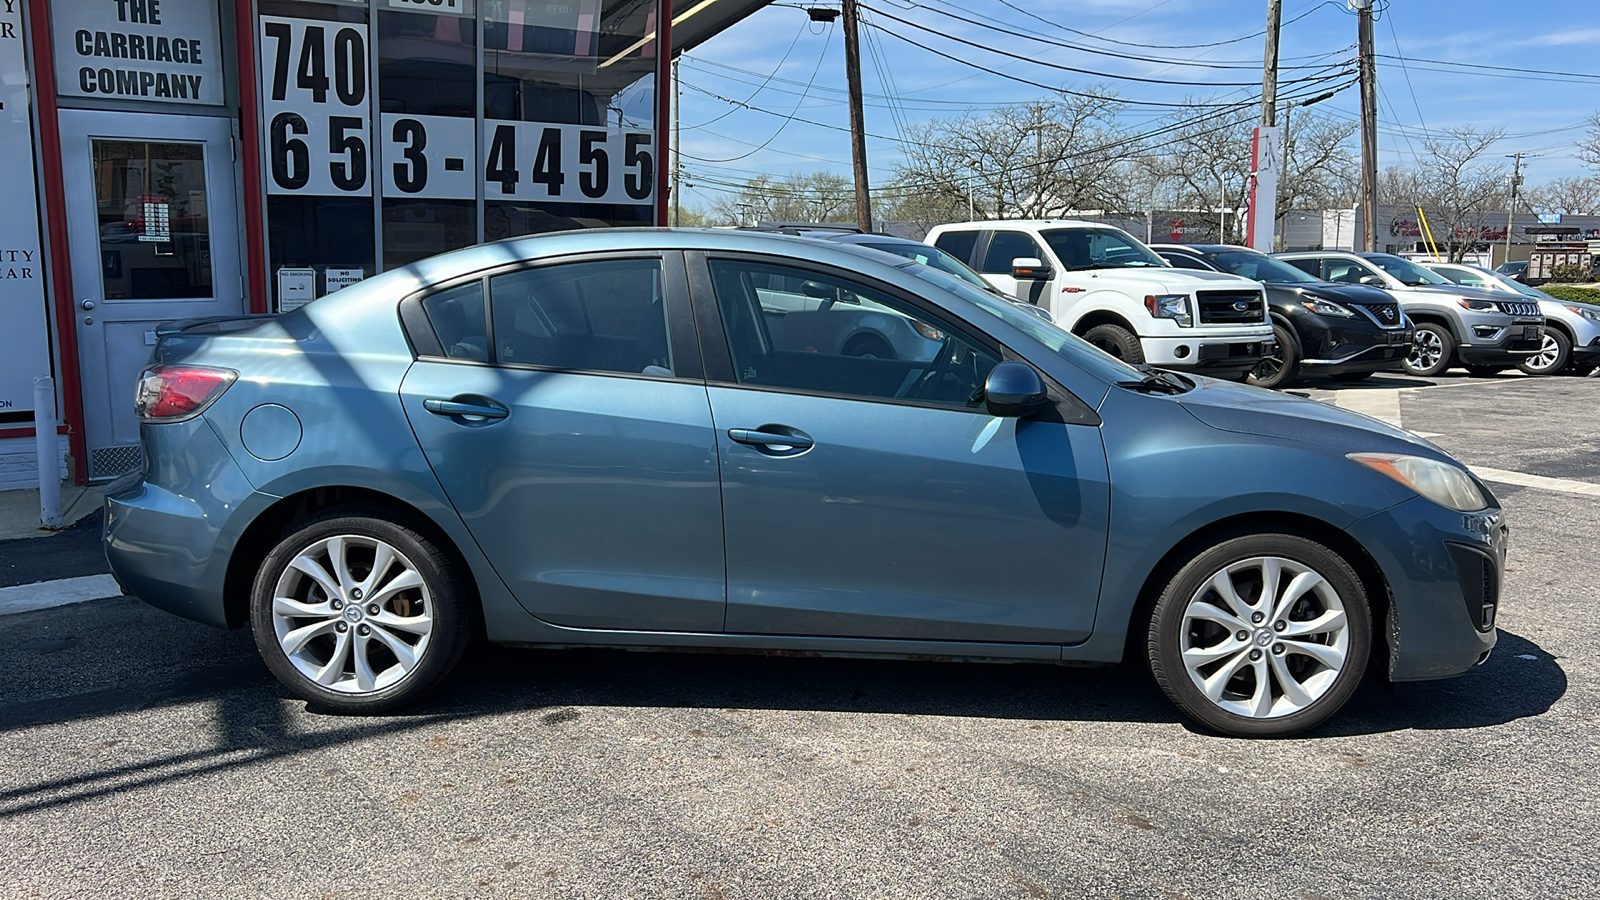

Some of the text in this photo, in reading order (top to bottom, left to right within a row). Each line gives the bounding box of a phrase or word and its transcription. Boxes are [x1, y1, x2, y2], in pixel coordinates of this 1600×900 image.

[116, 0, 162, 25] THE
[75, 29, 203, 65] CARRIAGE
[264, 22, 366, 106] 740
[79, 66, 203, 100] COMPANY
